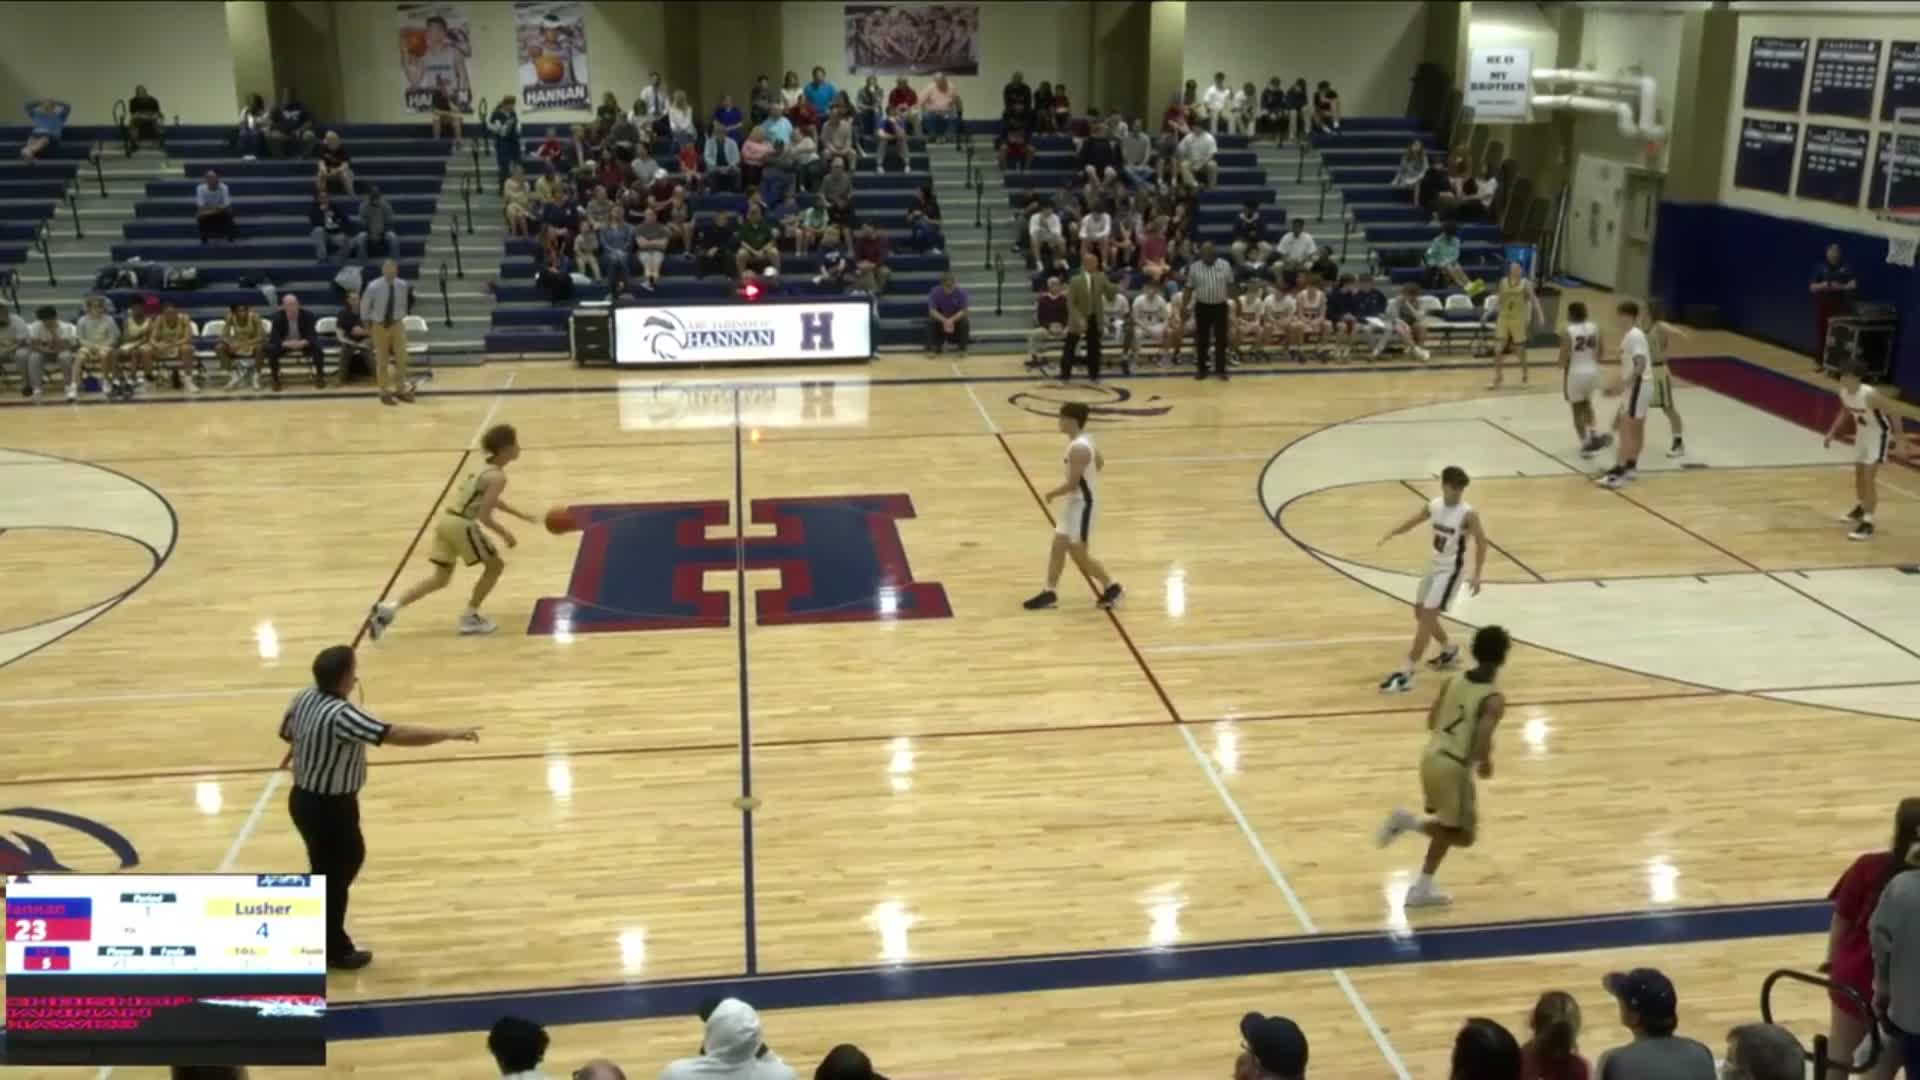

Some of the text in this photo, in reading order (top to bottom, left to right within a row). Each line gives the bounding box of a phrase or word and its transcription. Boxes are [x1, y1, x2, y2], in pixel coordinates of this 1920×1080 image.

[526, 85, 585, 105] HANNAN
[686, 329, 776, 347] HANNAN
[800, 312, 834, 351] H
[526, 493, 953, 635] H
[1441, 703, 1466, 736] 2
